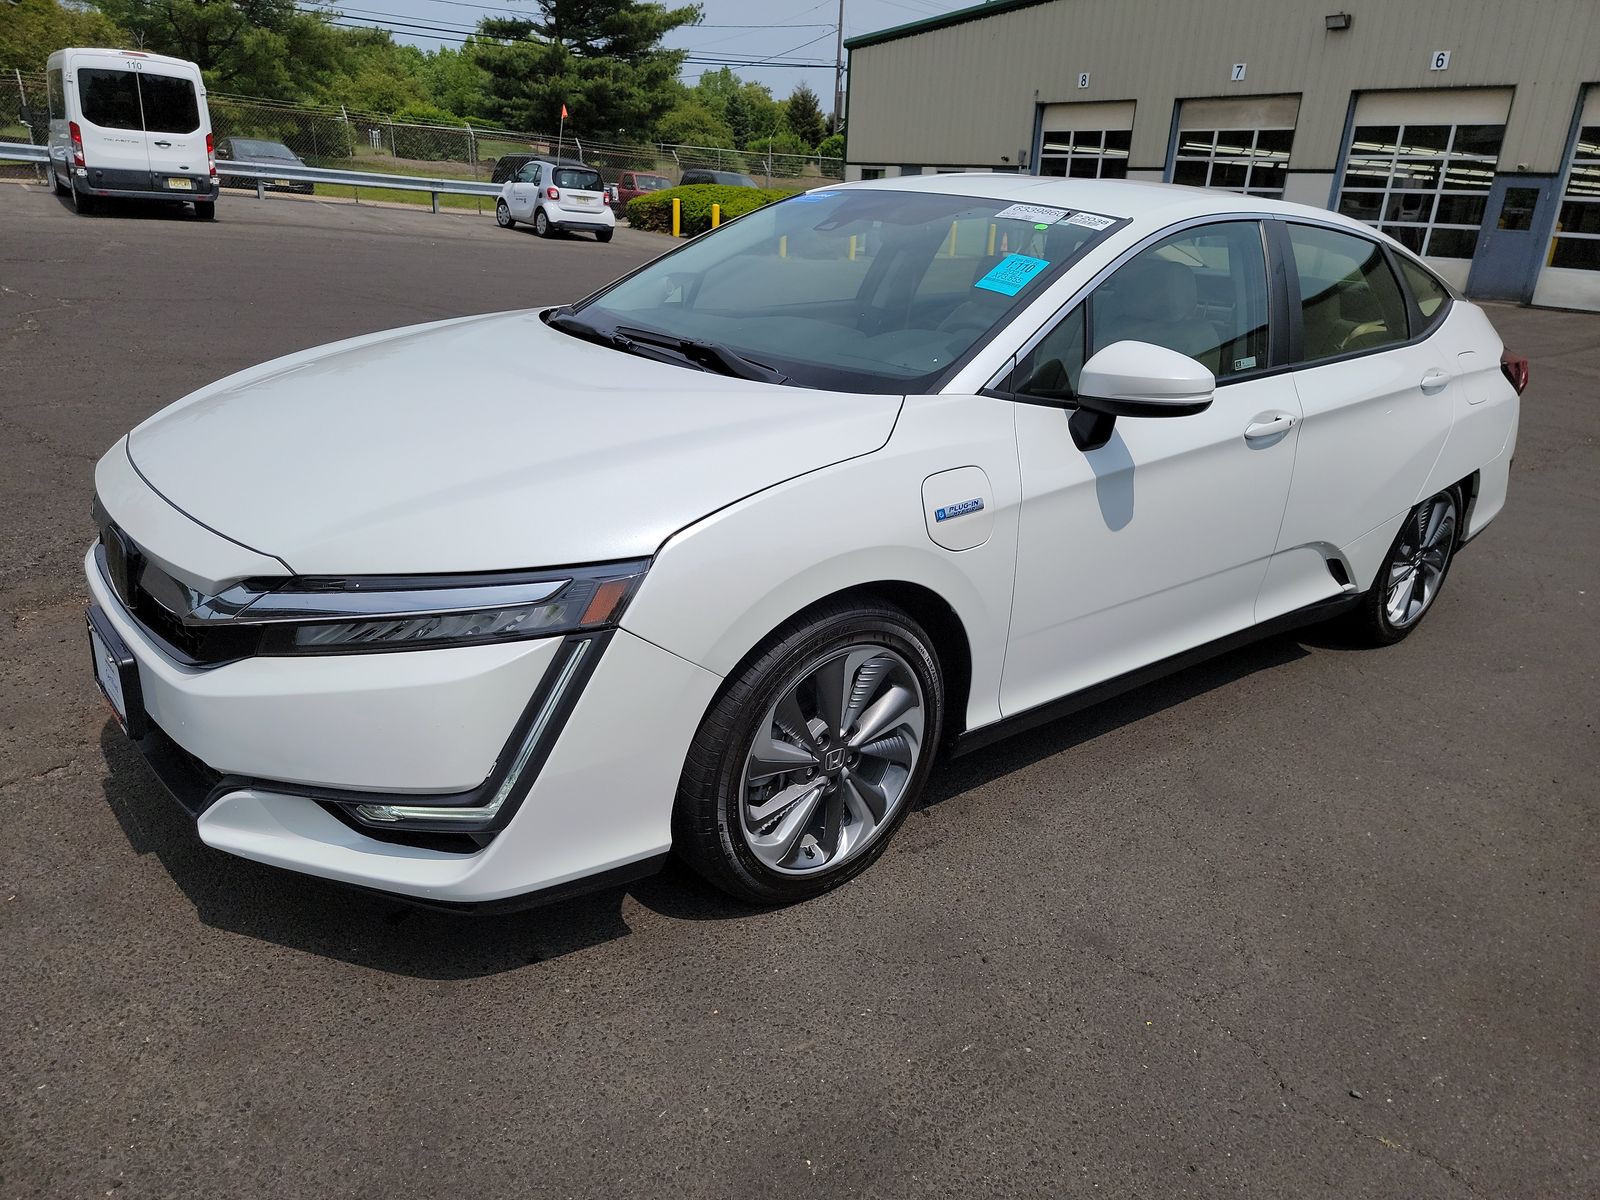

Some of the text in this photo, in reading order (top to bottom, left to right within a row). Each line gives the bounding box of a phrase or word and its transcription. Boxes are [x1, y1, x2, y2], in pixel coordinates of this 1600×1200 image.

[126, 61, 142, 70] 110
[1436, 52, 1445, 68] 6
[1236, 65, 1243, 79] 7
[1081, 74, 1087, 87] 8
[948, 500, 979, 513] PLUG-IN
